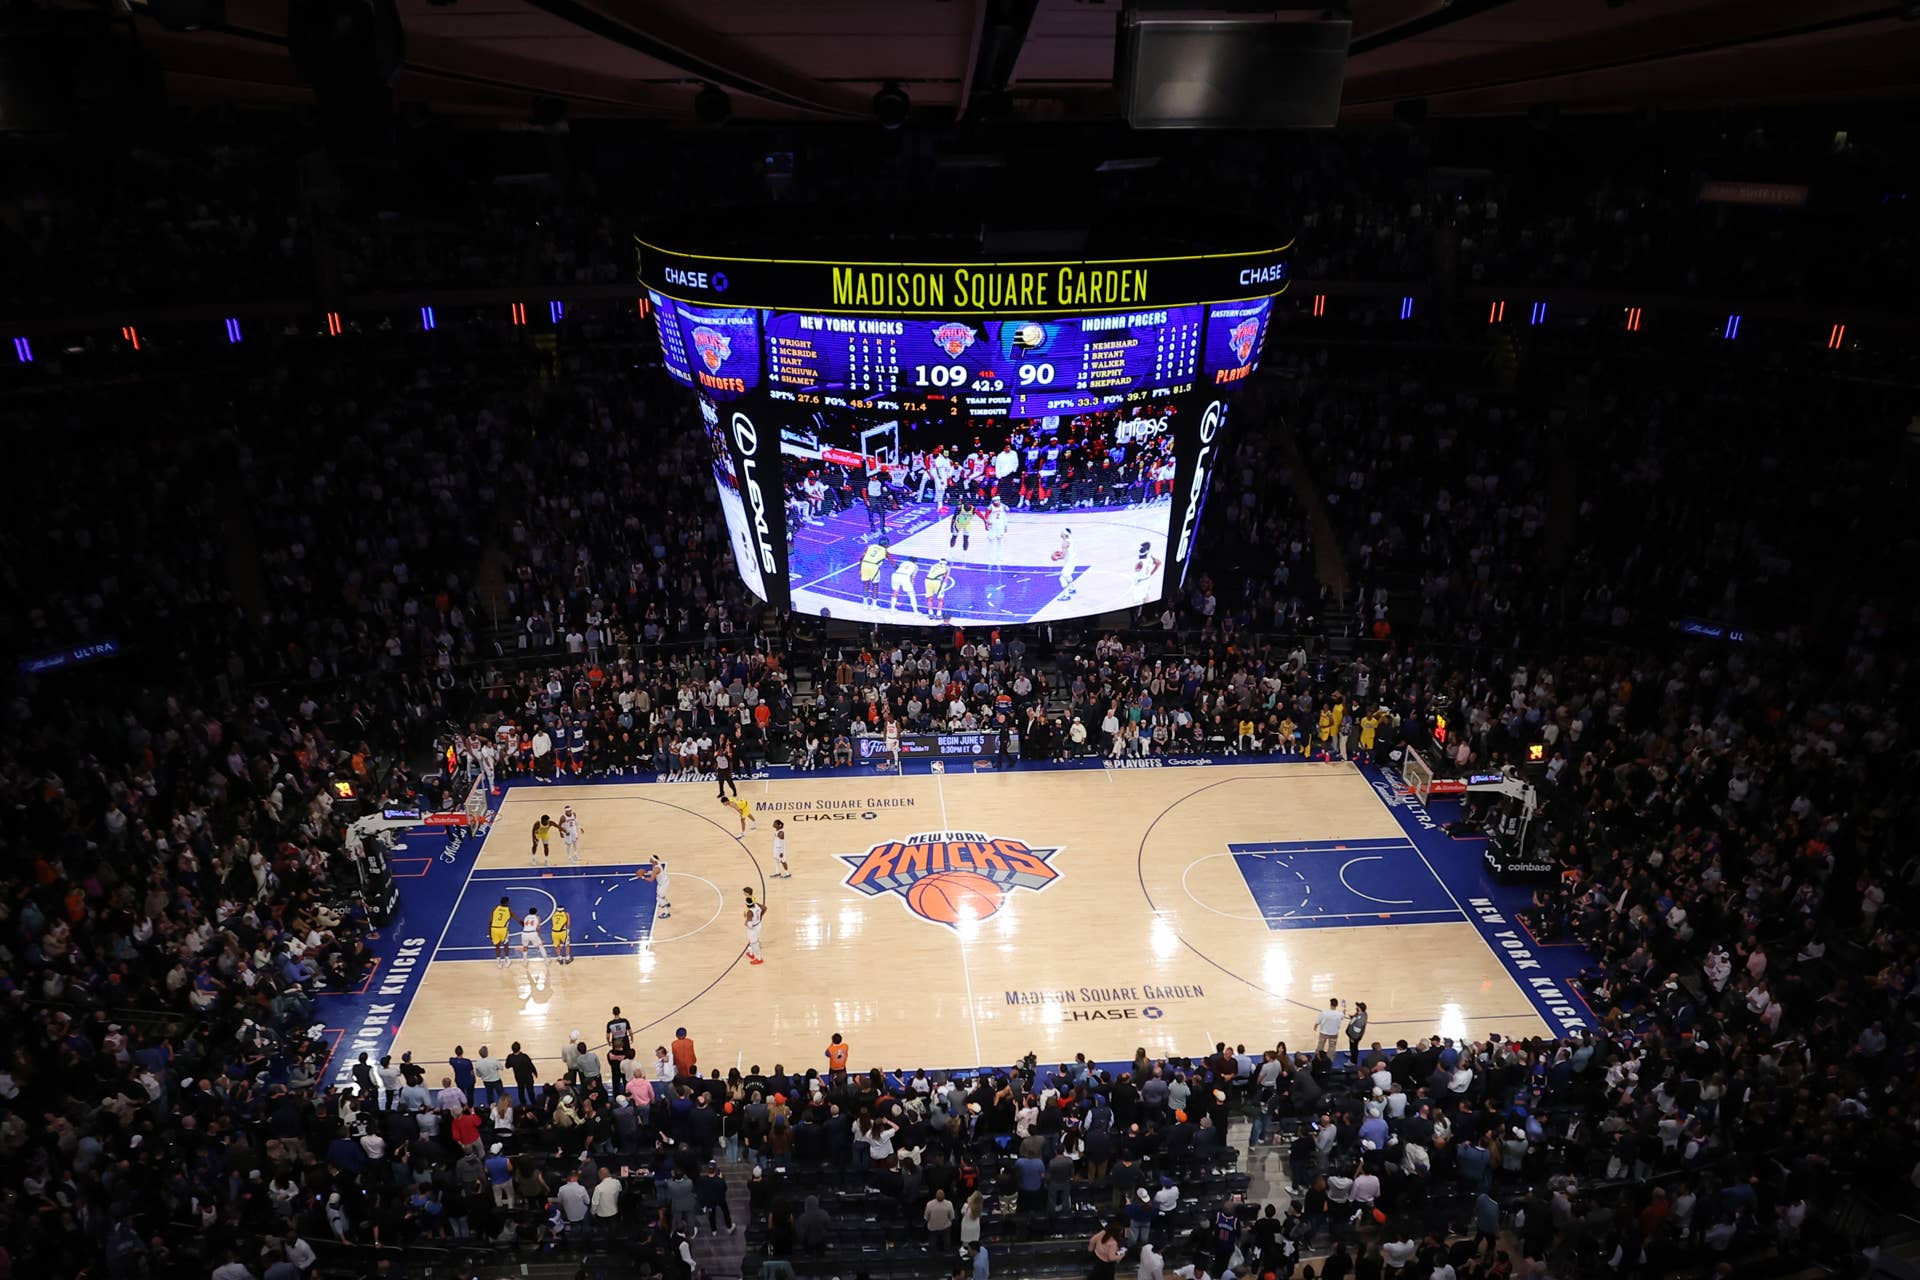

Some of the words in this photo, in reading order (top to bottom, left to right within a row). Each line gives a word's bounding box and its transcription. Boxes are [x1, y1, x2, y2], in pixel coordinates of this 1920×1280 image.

[666, 267, 708, 288] CHASE
[1240, 264, 1281, 285] CHASE
[832, 266, 946, 307] MADISON
[954, 266, 1047, 308] SQUARE
[1058, 267, 1148, 305] GARDEN
[800, 316, 823, 331] NEW
[826, 319, 856, 333] YORK
[859, 320, 903, 335] KNICKS
[1082, 316, 1125, 332] INDIANA
[1128, 312, 1167, 328] PACERS
[779, 338, 811, 348] WRIGHT
[1092, 339, 1138, 350] NEMBHARD
[780, 348, 817, 358] MCBRIDE
[1092, 350, 1124, 360] BRYANT
[780, 357, 802, 365] HART
[1091, 360, 1125, 369] WALKER
[781, 366, 818, 377] ACHIUWA
[916, 365, 967, 387] 109
[979, 370, 995, 378] 4th
[1019, 363, 1054, 385] 90
[1078, 372, 1087, 380] 12
[1091, 369, 1123, 379] FURPHY
[782, 375, 815, 385] SHAMET
[971, 380, 1003, 391] 42.9
[1090, 377, 1132, 388] SHEPPARD
[770, 391, 795, 401] 3PT%
[798, 394, 819, 404] 27.6
[825, 397, 846, 406] FG%
[850, 400, 873, 408] 48.9
[878, 401, 899, 410] FT%
[904, 403, 927, 411] 71.4
[1048, 399, 1074, 409] 3PT%
[1078, 397, 1099, 406] 33.3
[1103, 395, 1123, 404] FG%
[1127, 391, 1147, 401] 39.7
[1152, 388, 1170, 398] FT%
[1173, 383, 1192, 394] 81.5
[951, 407, 957, 415] 2
[1118, 416, 1168, 439] Infosys
[743, 459, 777, 575] LEXUS
[74, 642, 113, 660] ULTRA
[938, 736, 959, 746] BEGIN
[960, 736, 978, 745] JUNE
[979, 736, 984, 744] 5
[963, 745, 970, 753] ET
[1114, 758, 1163, 768] PLAYOFFS
[1168, 758, 1212, 766] Google
[667, 772, 718, 782] PLAYOFFS
[756, 801, 811, 811] MADISON
[816, 800, 863, 809] SQUARE
[868, 798, 914, 807] GARDEN
[793, 813, 857, 822] CHASE
[1403, 796, 1436, 830] ULTRA
[908, 833, 942, 844] NEW
[946, 832, 987, 843] YORK
[846, 838, 1059, 887] KNICKS
[1508, 862, 1551, 871] coinbase
[498, 913, 503, 921] 3
[1468, 898, 1506, 924] NEW
[1494, 930, 1541, 970] YORK
[351, 1003, 396, 1049] YORK
[378, 938, 426, 995] KNICKS
[1005, 991, 1076, 1005] MADION
[1081, 987, 1139, 1003] SQUARE
[1144, 984, 1205, 999] GARDEN
